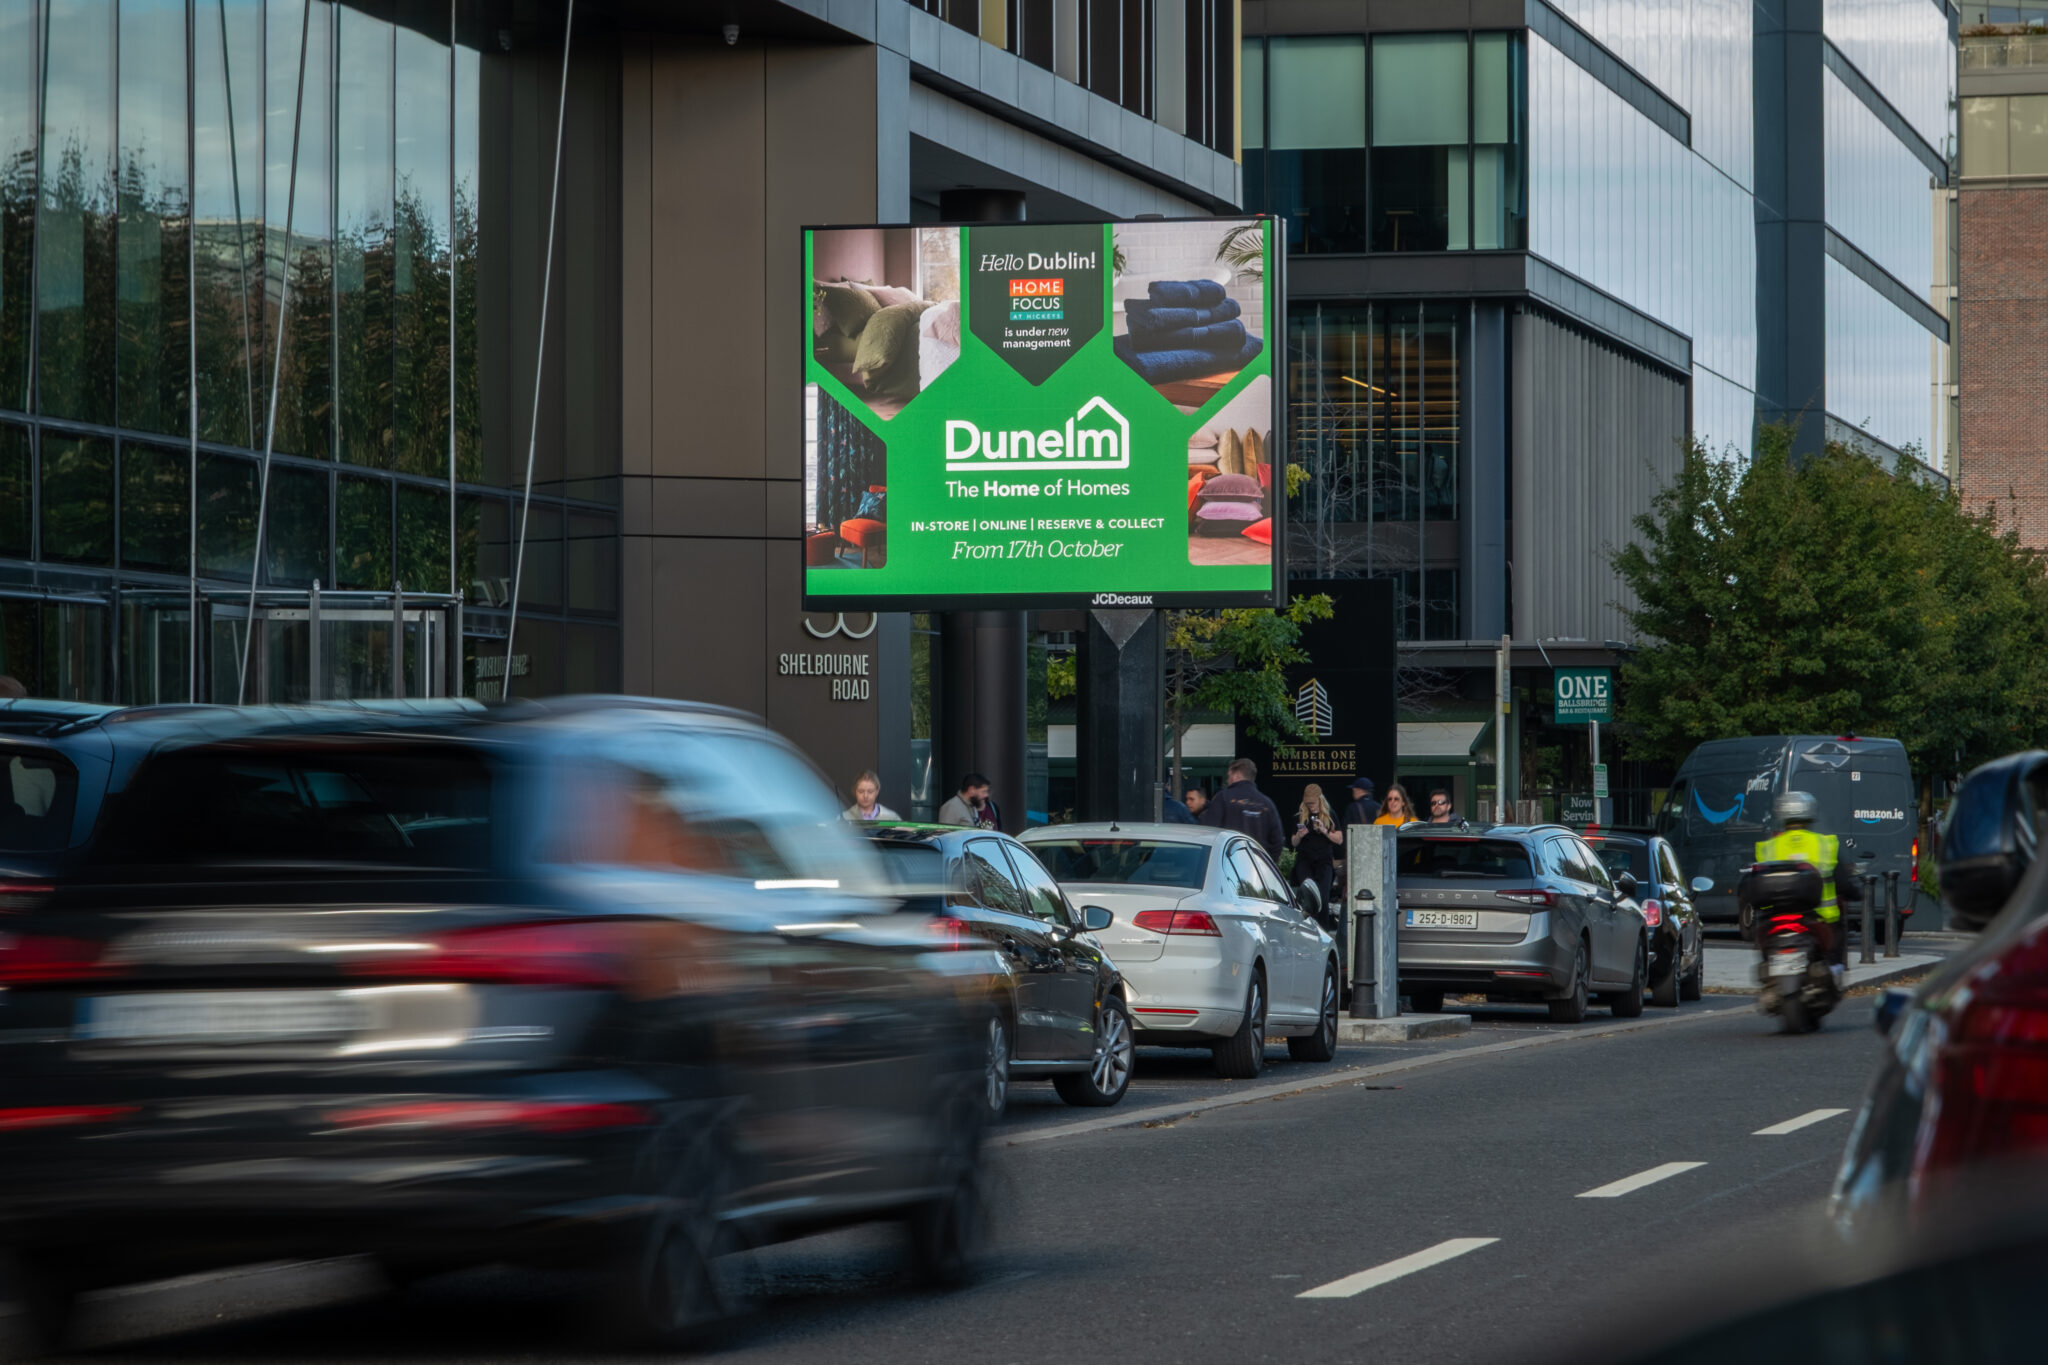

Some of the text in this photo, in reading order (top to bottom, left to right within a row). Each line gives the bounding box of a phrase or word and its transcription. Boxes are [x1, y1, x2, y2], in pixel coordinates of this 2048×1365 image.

[979, 251, 1096, 272] Hello Dublin!
[1012, 281, 1060, 294] HOME
[1012, 297, 1061, 310] FOCUS
[1004, 326, 1069, 337] is under new
[1003, 338, 1071, 350] management
[946, 416, 1118, 460] Dunelm
[945, 478, 1130, 498] The Home of Homes
[911, 518, 1165, 532] IN-STORE ONLINE RESERVE & COLLECT
[951, 540, 1123, 559] From 17th October
[1092, 593, 1153, 605] JCDecaux
[780, 653, 869, 675] SHELBOURNE
[833, 679, 870, 700] ROAD
[1558, 676, 1607, 698] ONE
[1558, 699, 1607, 707] BALLSBRIDGE
[1331, 750, 1356, 760] ONE
[1272, 761, 1356, 771] BALLSBRIDGE
[1746, 774, 1769, 795] prime
[1571, 797, 1593, 808] Now
[1563, 810, 1594, 821] Servin
[1854, 808, 1904, 820] amazon.ie
[1419, 913, 1473, 925] 252-D-19812
